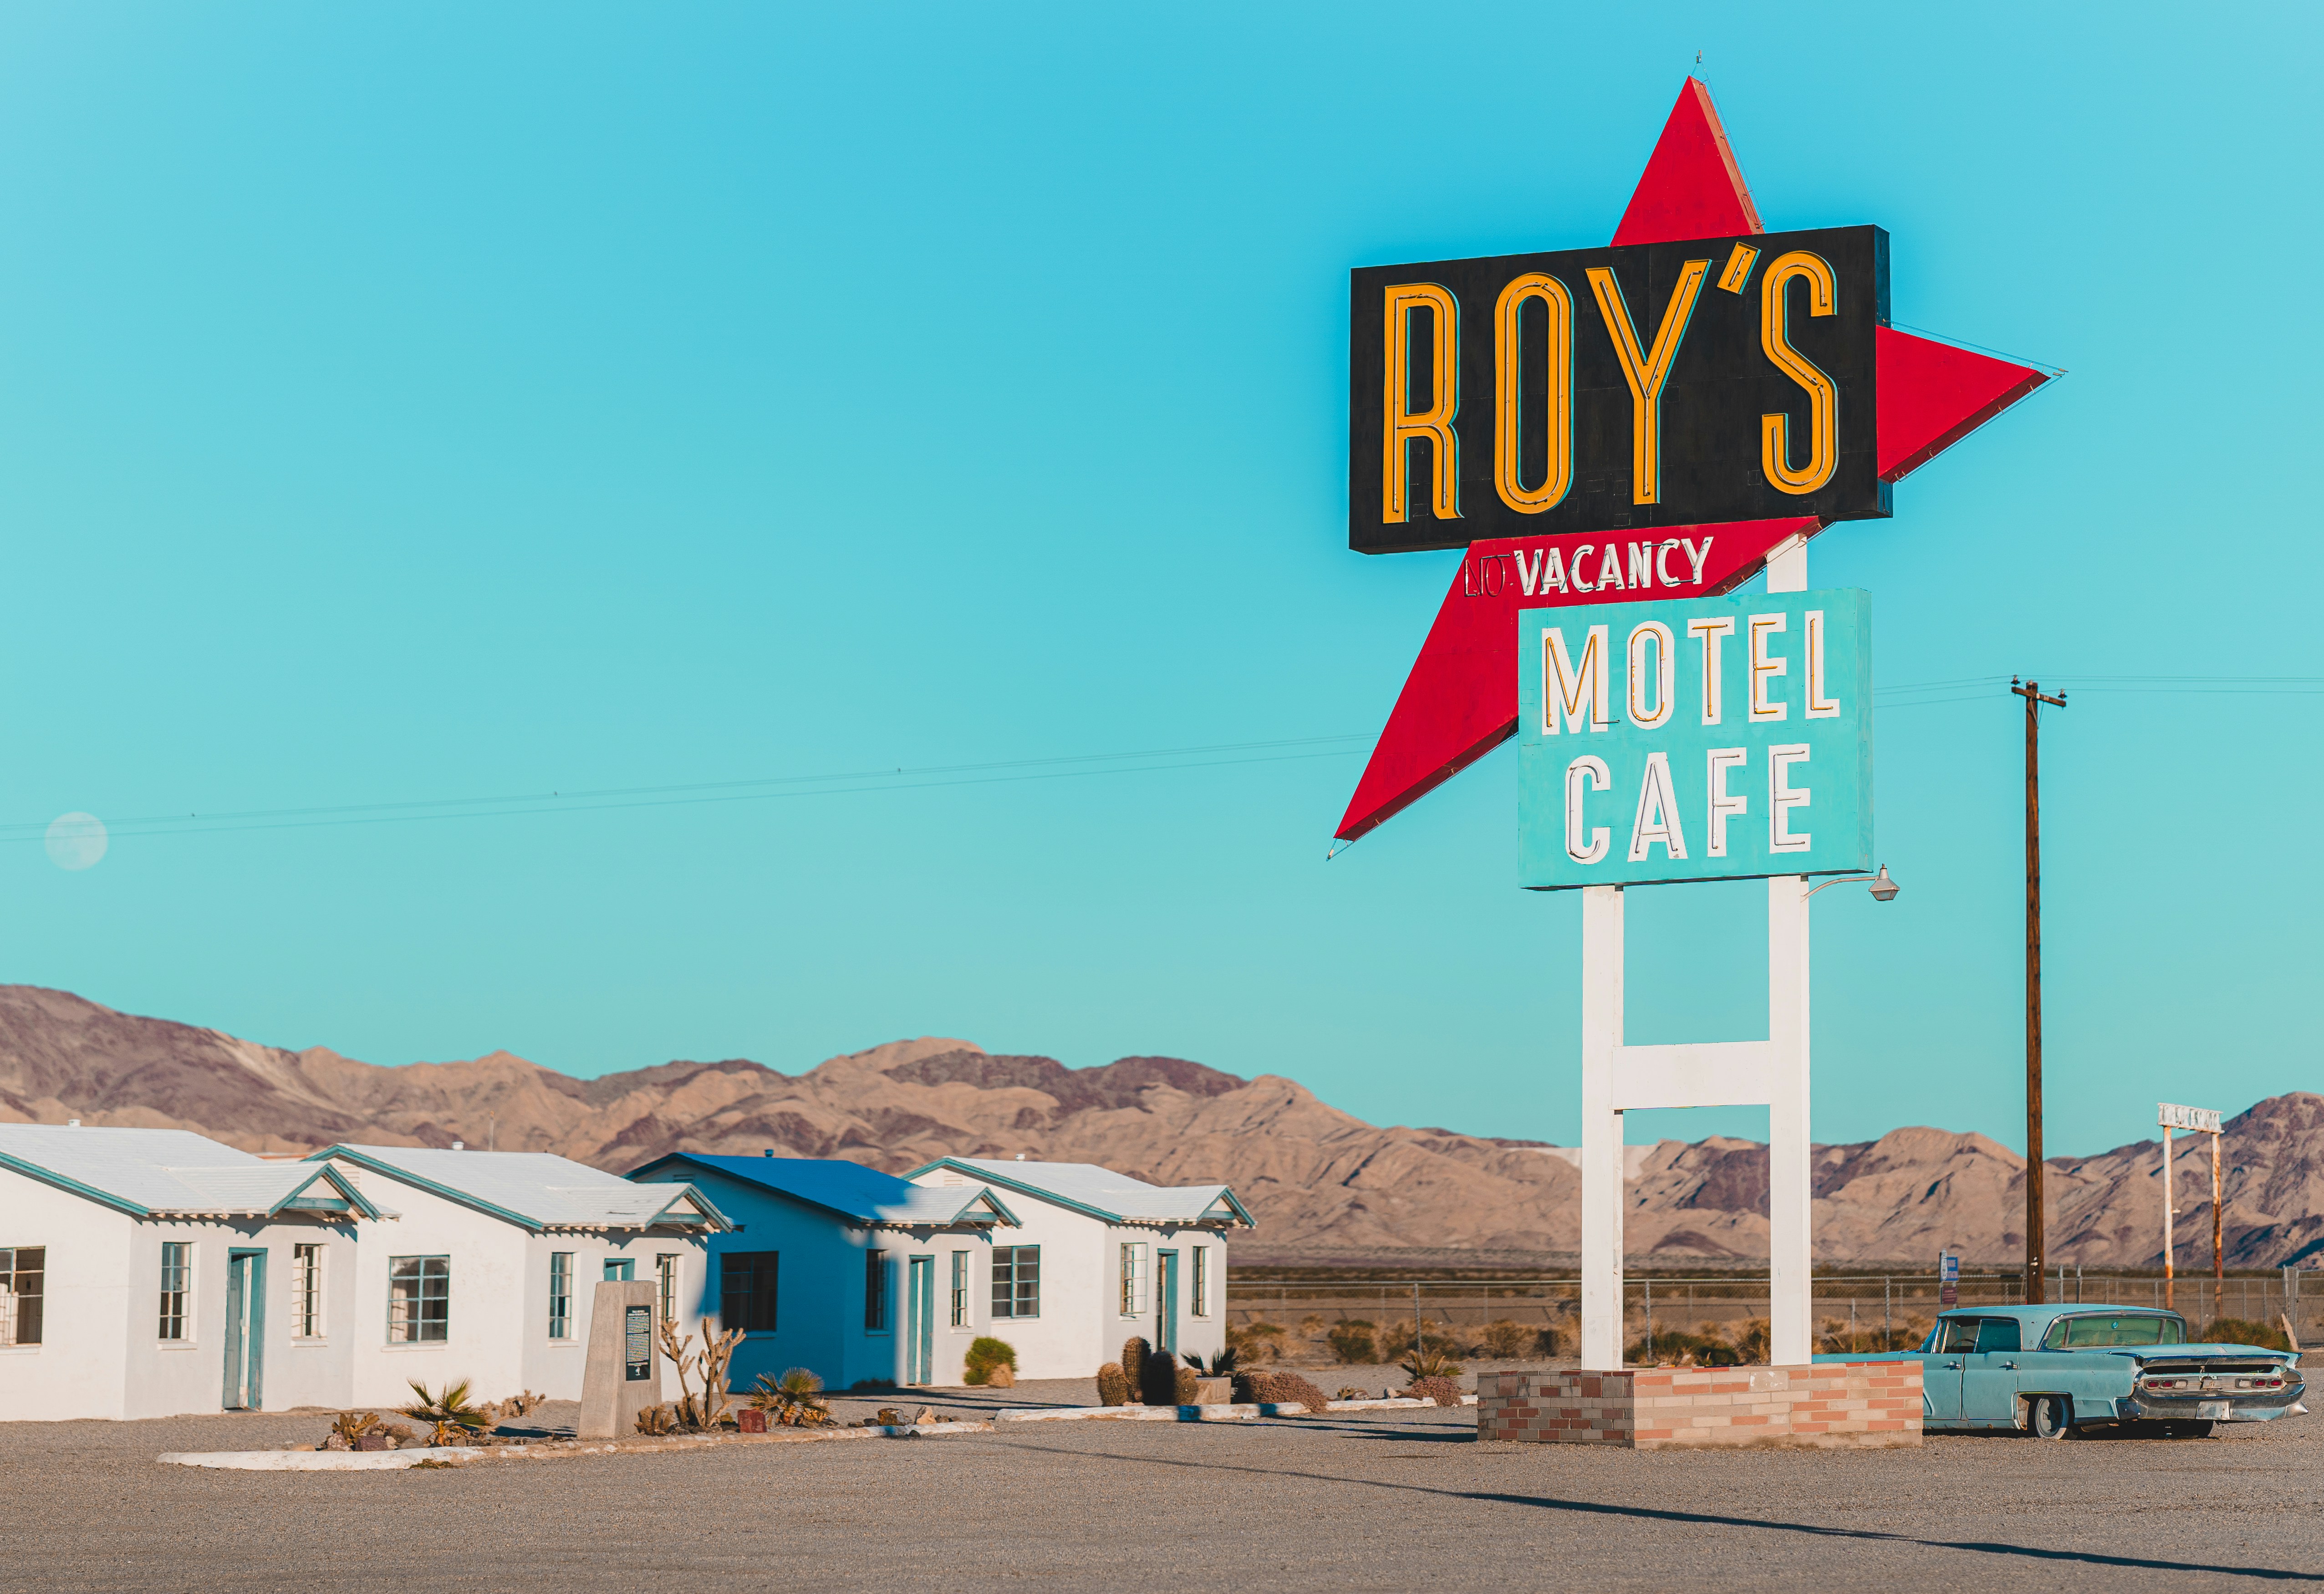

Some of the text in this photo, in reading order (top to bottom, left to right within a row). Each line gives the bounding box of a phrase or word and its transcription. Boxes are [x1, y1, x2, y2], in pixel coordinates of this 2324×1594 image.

[1383, 242, 1838, 524] ROY'S
[1463, 536, 1714, 597] NO VACANCY
[1541, 610, 1840, 736] MOTEL
[1565, 743, 1811, 865] CAFE
